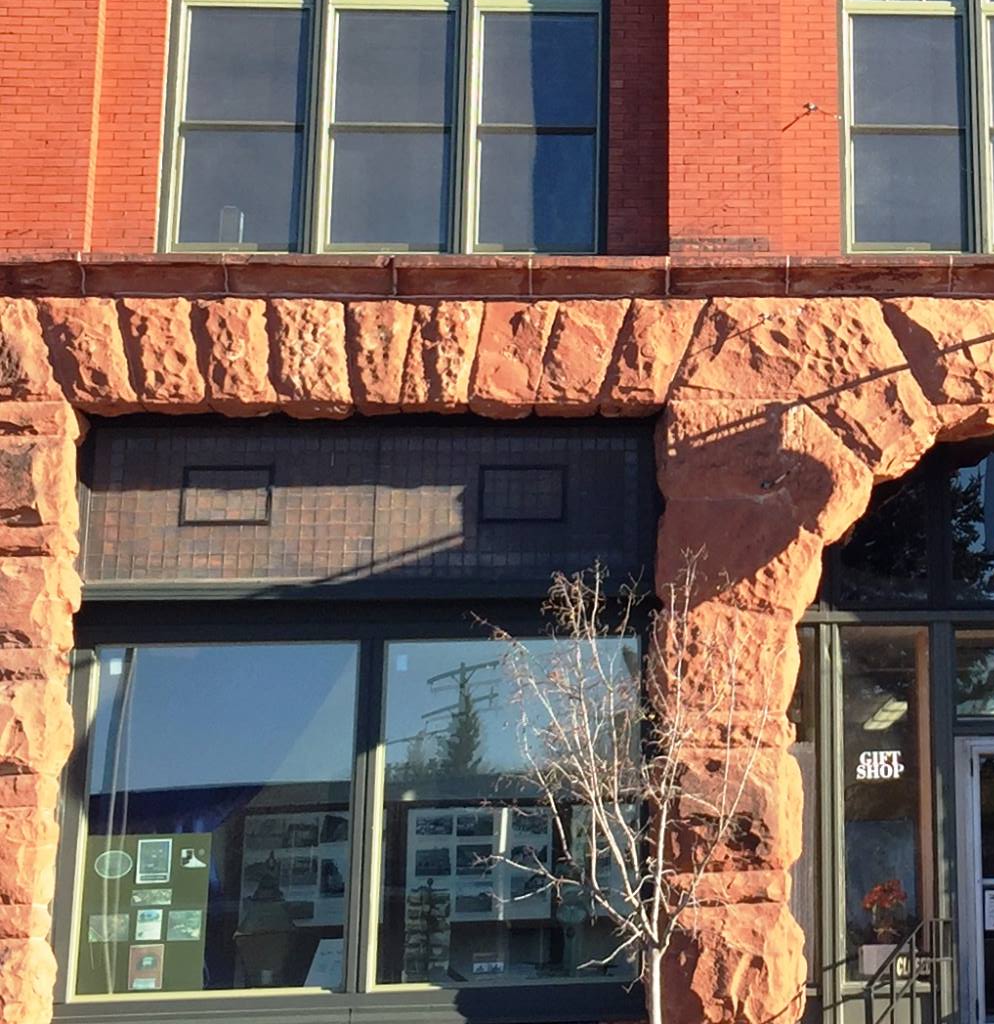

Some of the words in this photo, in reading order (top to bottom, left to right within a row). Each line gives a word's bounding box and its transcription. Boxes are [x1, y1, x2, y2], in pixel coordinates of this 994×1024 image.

[859, 750, 902, 765] GIFT
[855, 763, 905, 779] SHOP
[896, 956, 931, 976] CLSED
